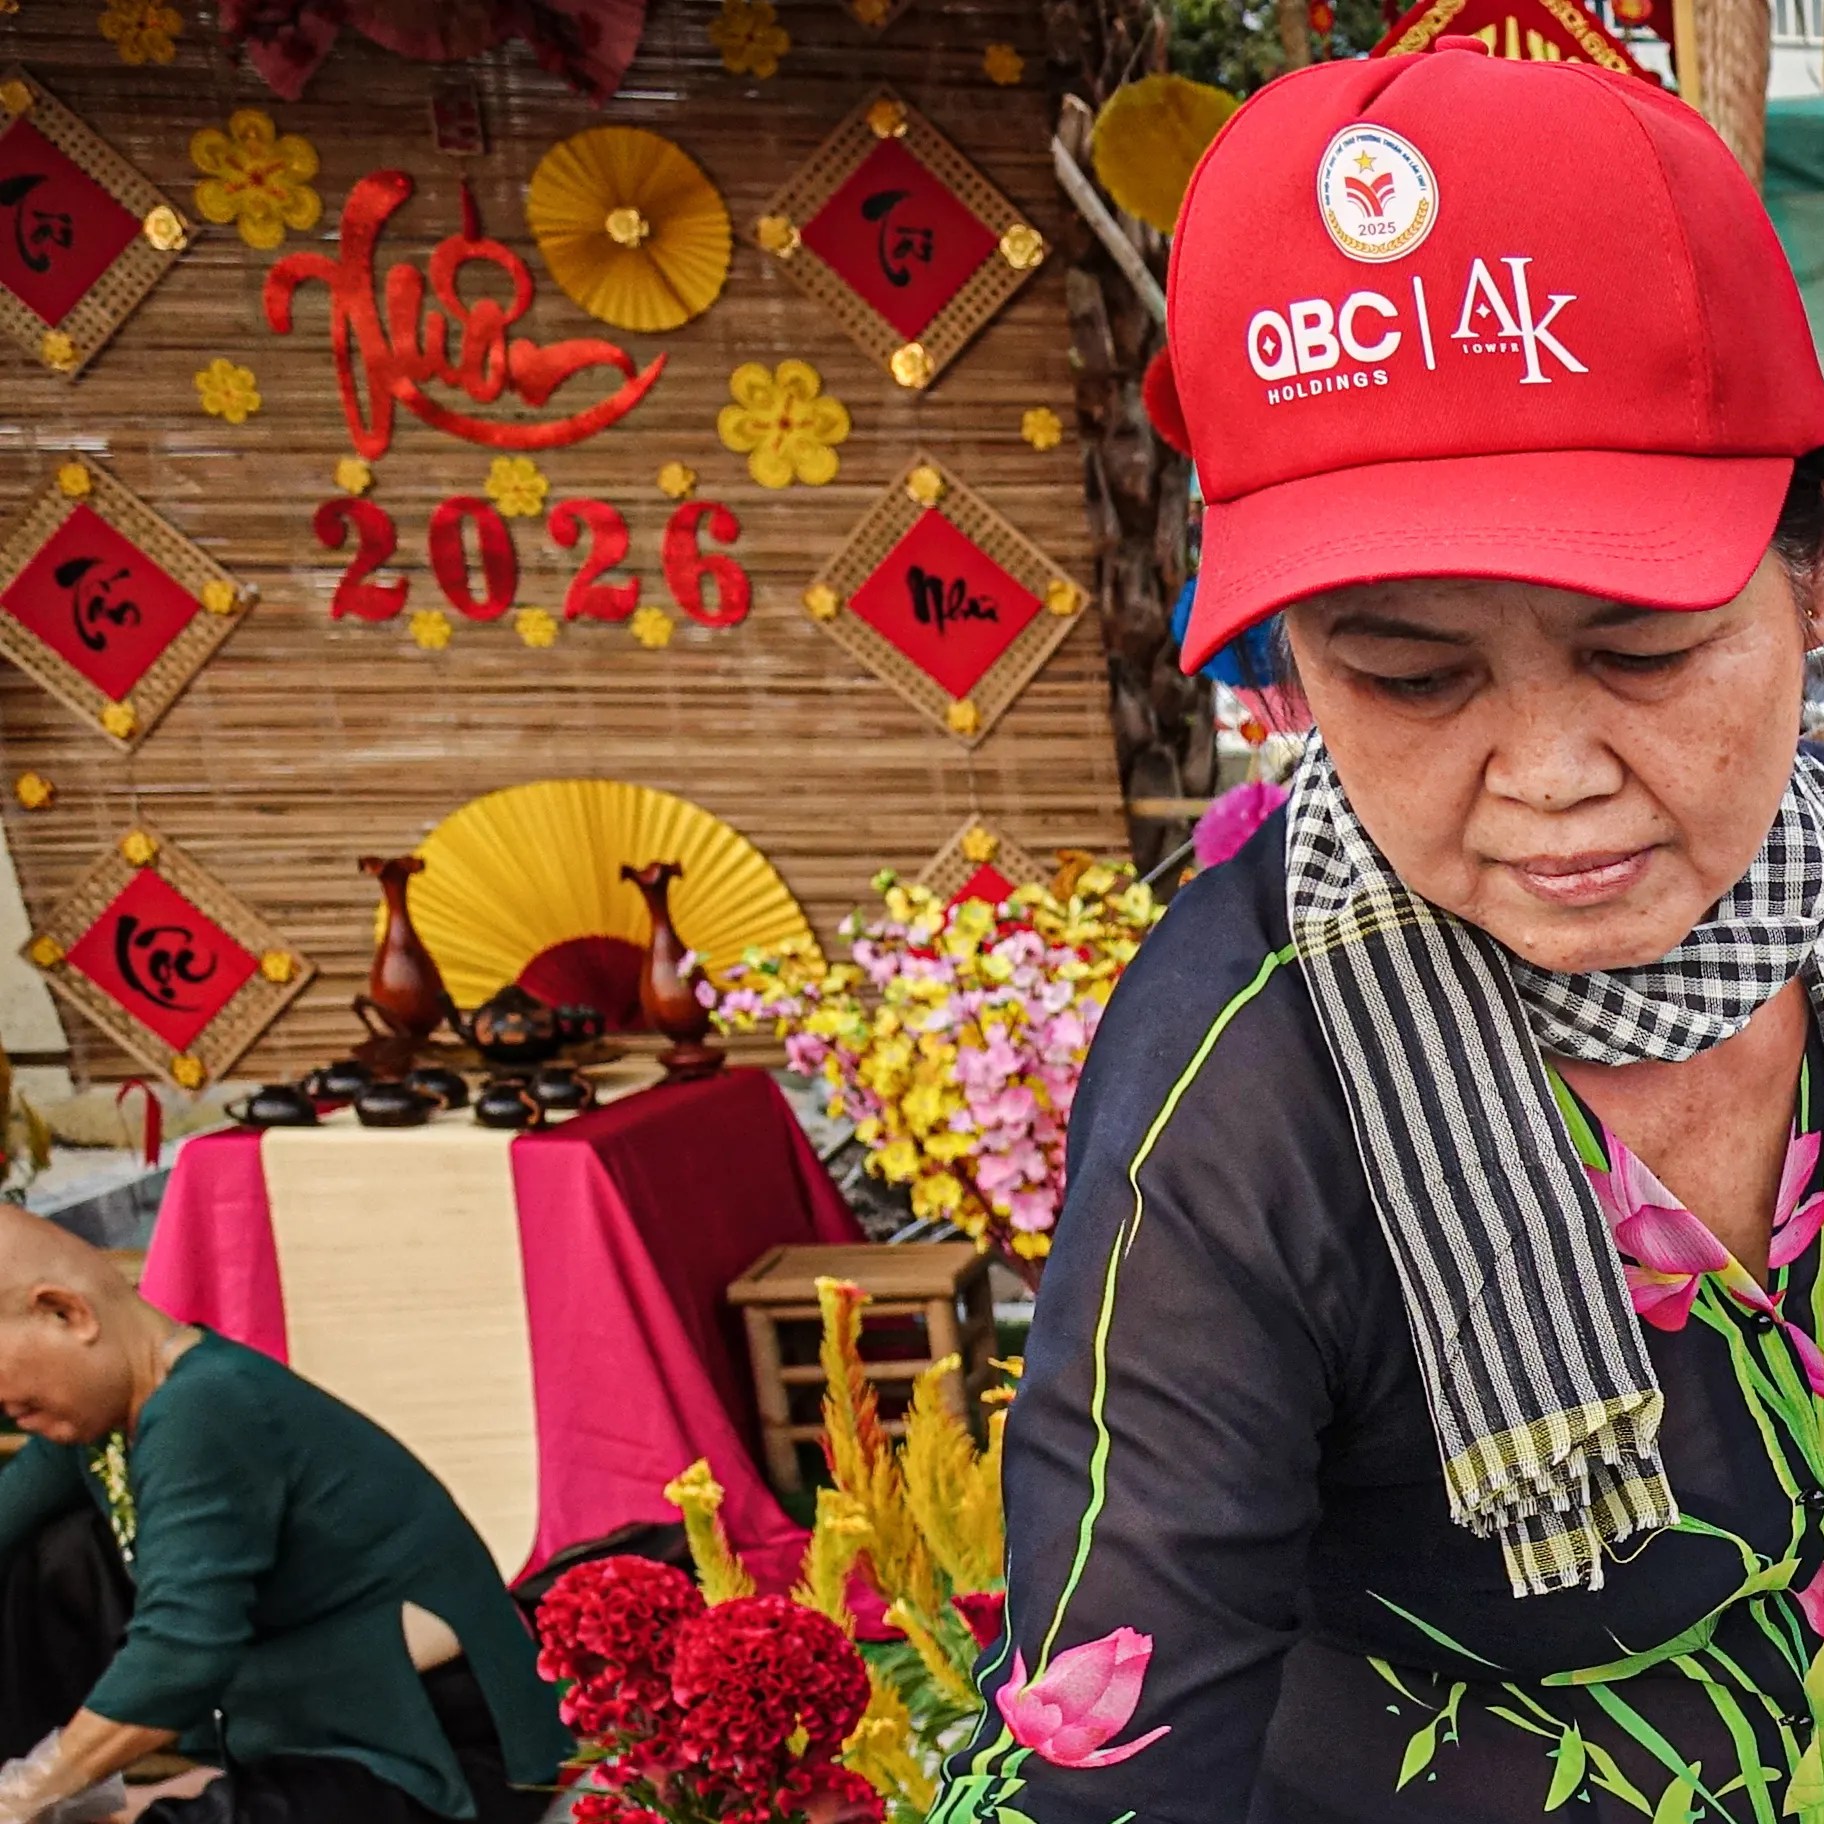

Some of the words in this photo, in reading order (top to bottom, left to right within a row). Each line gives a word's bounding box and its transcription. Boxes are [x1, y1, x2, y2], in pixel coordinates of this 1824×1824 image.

[1358, 221, 1397, 237] 2025
[1267, 369, 1389, 406] HOLDINGS
[313, 495, 752, 628] 2026
